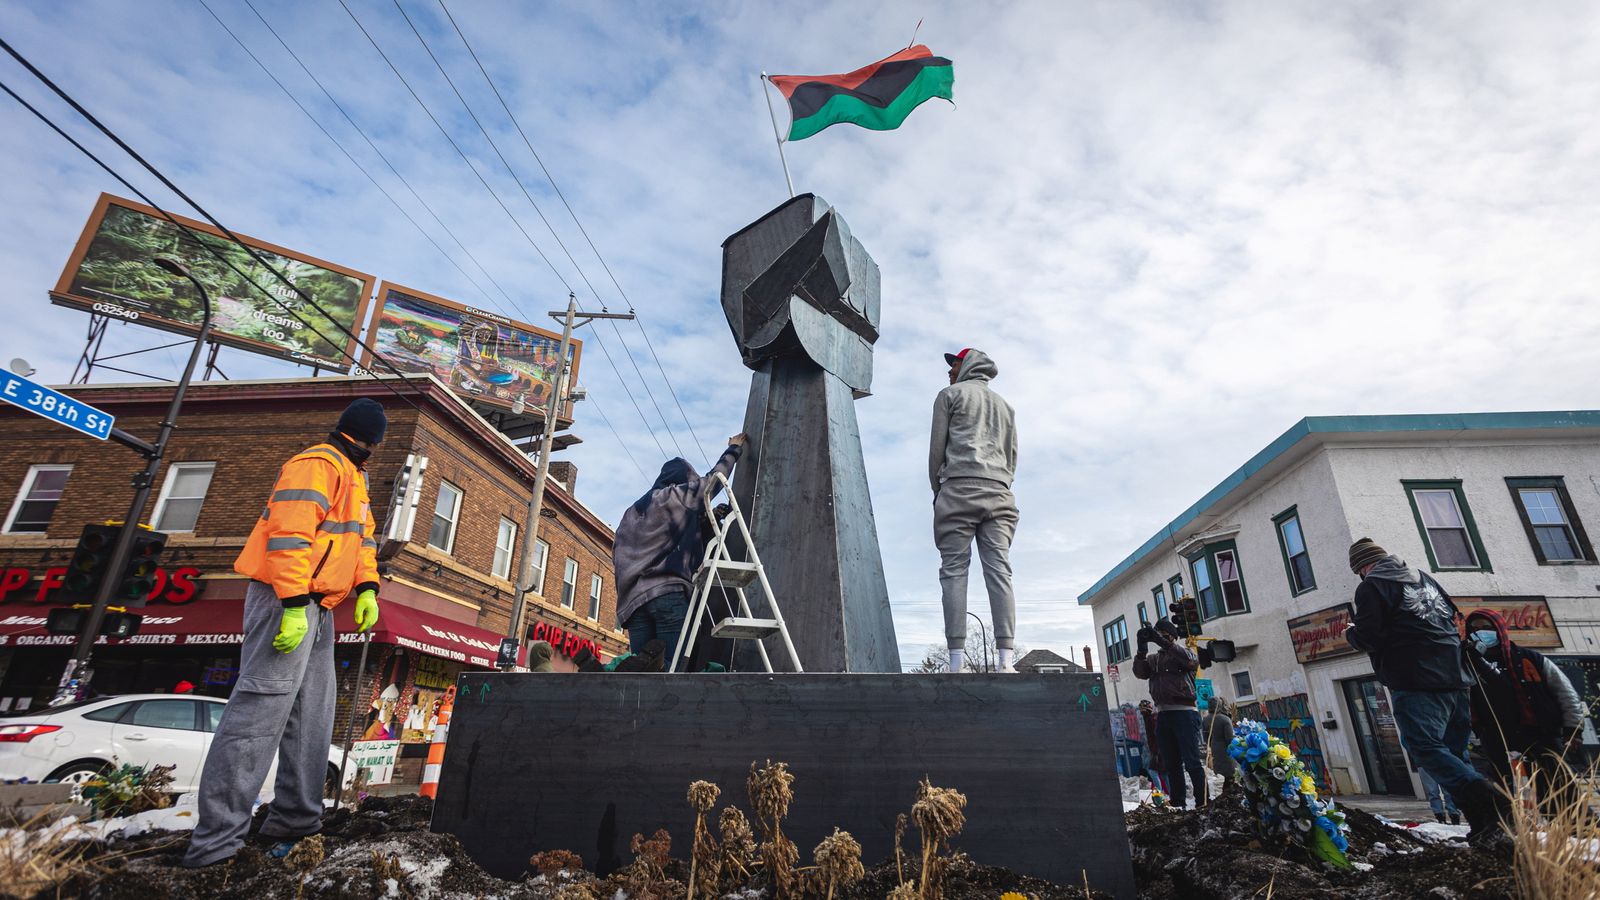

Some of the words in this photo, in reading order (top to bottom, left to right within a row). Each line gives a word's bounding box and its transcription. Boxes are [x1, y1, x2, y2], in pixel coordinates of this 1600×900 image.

[277, 286, 298, 299] full
[92, 302, 139, 320] 032540
[253, 310, 303, 330] dreams
[262, 327, 285, 340] too
[4, 379, 22, 397] E
[28, 390, 78, 421] 38th
[85, 414, 107, 433] St
[16, 635, 76, 645] ORGANIC
[118, 634, 176, 644] -SHIRTS
[184, 634, 245, 644] MEXICAN
[422, 643, 450, 658] EASTERN
[450, 650, 466, 661] FOOD
